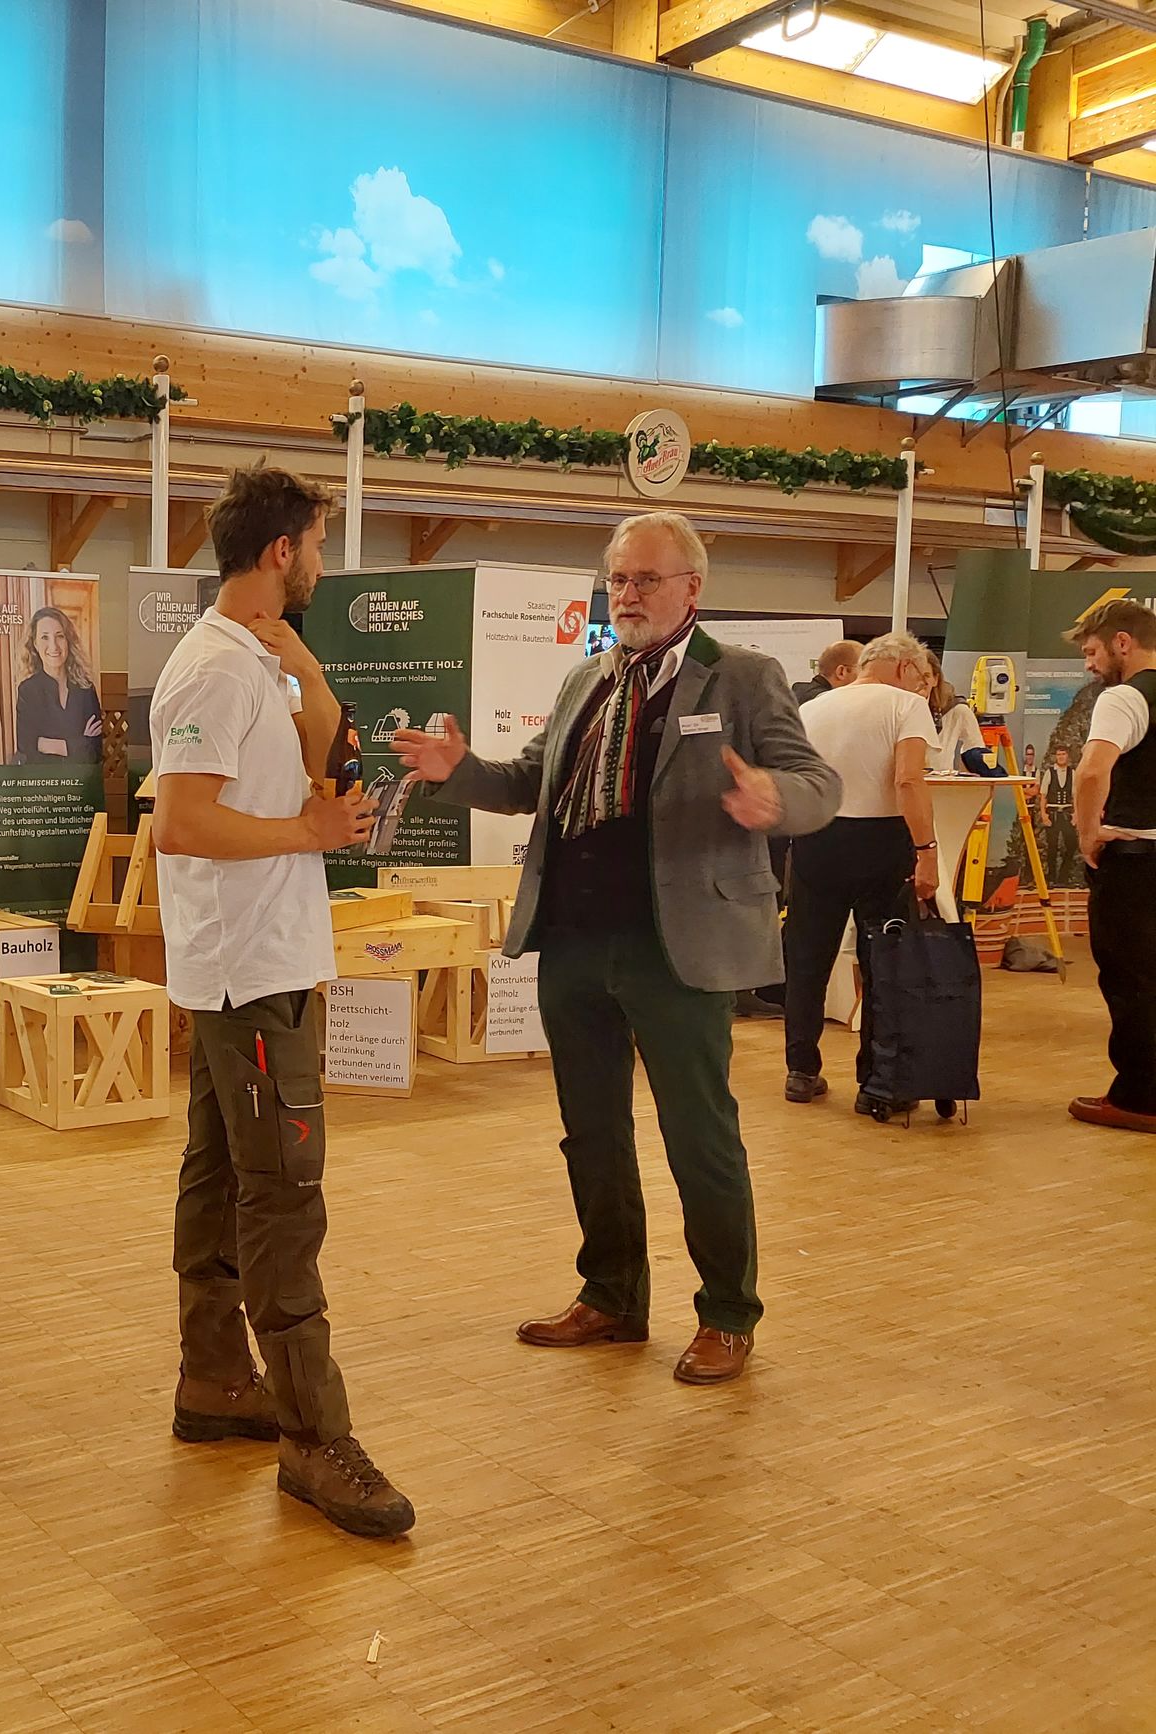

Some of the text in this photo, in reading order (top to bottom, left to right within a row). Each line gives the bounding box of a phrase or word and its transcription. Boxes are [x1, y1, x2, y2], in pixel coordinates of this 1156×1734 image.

[156, 592, 171, 601] WIR
[369, 592, 386, 601] WIR
[2, 605, 18, 613] AUF
[156, 603, 197, 613] BAUEN AUF
[369, 600, 419, 611] BAUEN AUF
[156, 613, 200, 623] HEIMISCHES
[369, 611, 424, 621] HEIMISCHES
[482, 611, 555, 621] Fachschule Rosenheim
[156, 624, 175, 632] HOLZ
[369, 622, 409, 632] HOLZ e.V.
[320, 661, 463, 672] ERTSCHÖPFUNGSKETTE HOLZ
[351, 676, 379, 684] Keimling
[495, 710, 511, 719] Holz
[521, 715, 548, 726] TECH
[497, 724, 510, 732] Bau
[23, 795, 65, 803] nachhaltigen
[13, 805, 51, 814] vorbeiführt,
[37, 828, 67, 836] gestalten
[393, 838, 458, 848] Rohstoff profitie-
[391, 850, 425, 858] wertvolle
[362, 859, 386, 868] Region
[2, 939, 53, 954] Bauholz
[492, 960, 510, 968] KVH
[330, 986, 354, 996] BSH
[490, 990, 518, 998] vollholz
[330, 1004, 392, 1015] Brettschicht-
[330, 1019, 350, 1028] holz
[340, 1033, 353, 1041] der
[356, 1034, 378, 1044] Länge
[381, 1036, 404, 1045] durch
[330, 1046, 375, 1057] Keilzinkung
[329, 1059, 372, 1068] verbunden
[329, 1071, 404, 1083] Schichten verleimt
